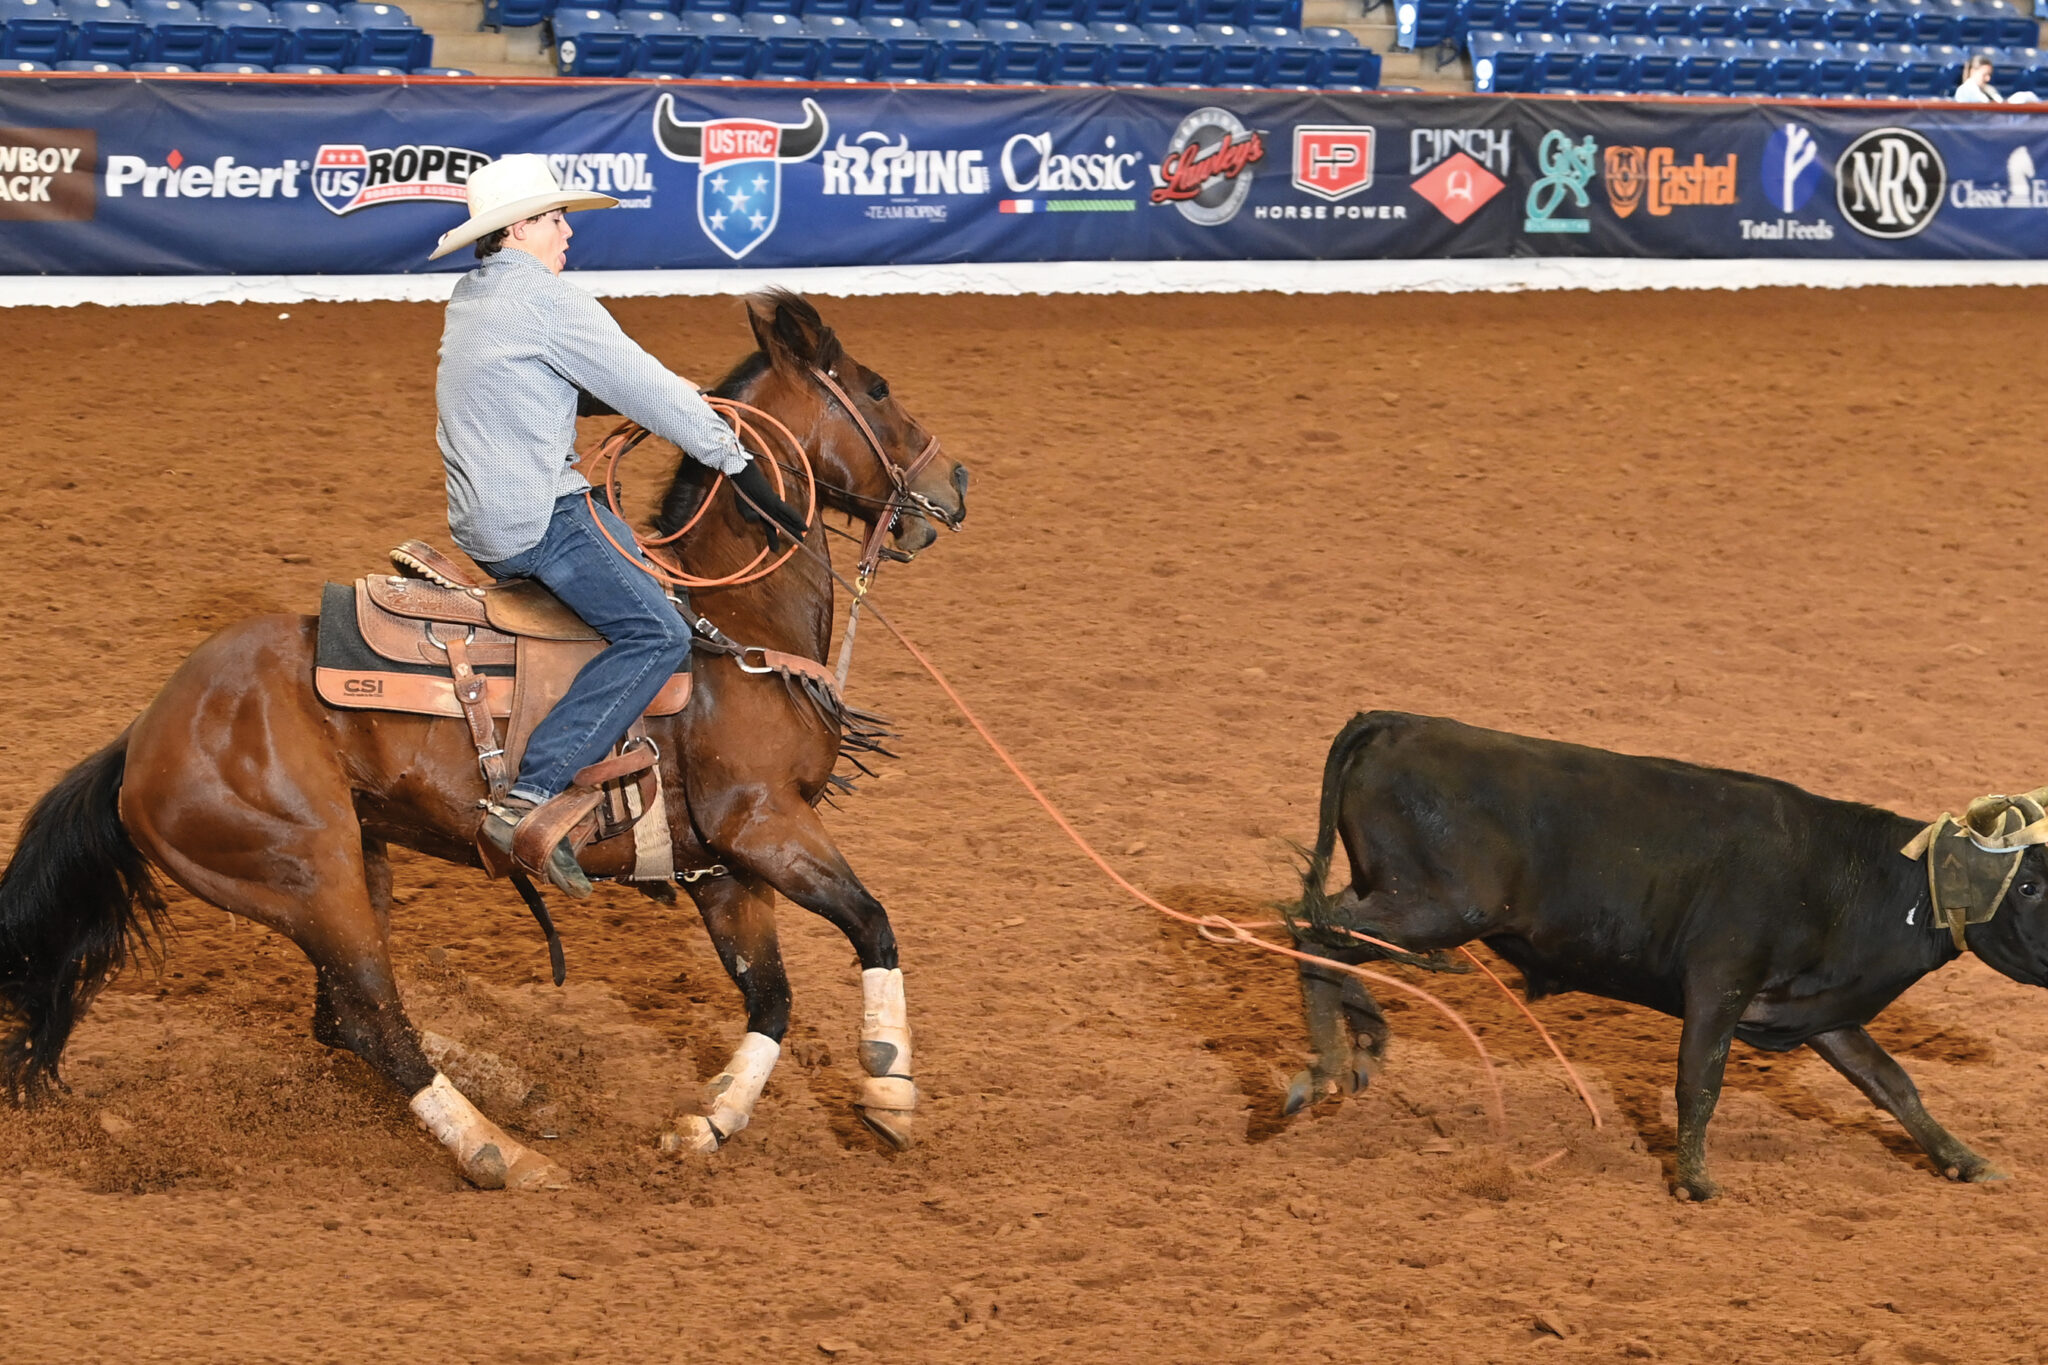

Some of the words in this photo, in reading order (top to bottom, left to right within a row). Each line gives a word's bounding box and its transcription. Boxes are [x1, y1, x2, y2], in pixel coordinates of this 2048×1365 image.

[709, 128, 775, 154] USTRC
[1410, 128, 1512, 177] CINCH
[105, 149, 301, 197] Priefert
[501, 153, 653, 191] SISTOL
[1001, 132, 1136, 192] Classic
[320, 170, 360, 197] US
[1851, 138, 1929, 226] NRS
[1950, 178, 2007, 209] Classic
[619, 195, 652, 208] ound
[1254, 205, 1327, 219] HORSE
[1333, 205, 1407, 219] POWER
[1739, 218, 1784, 240] Total
[1786, 218, 1834, 240] Feeds
[344, 679, 383, 693] CSI
